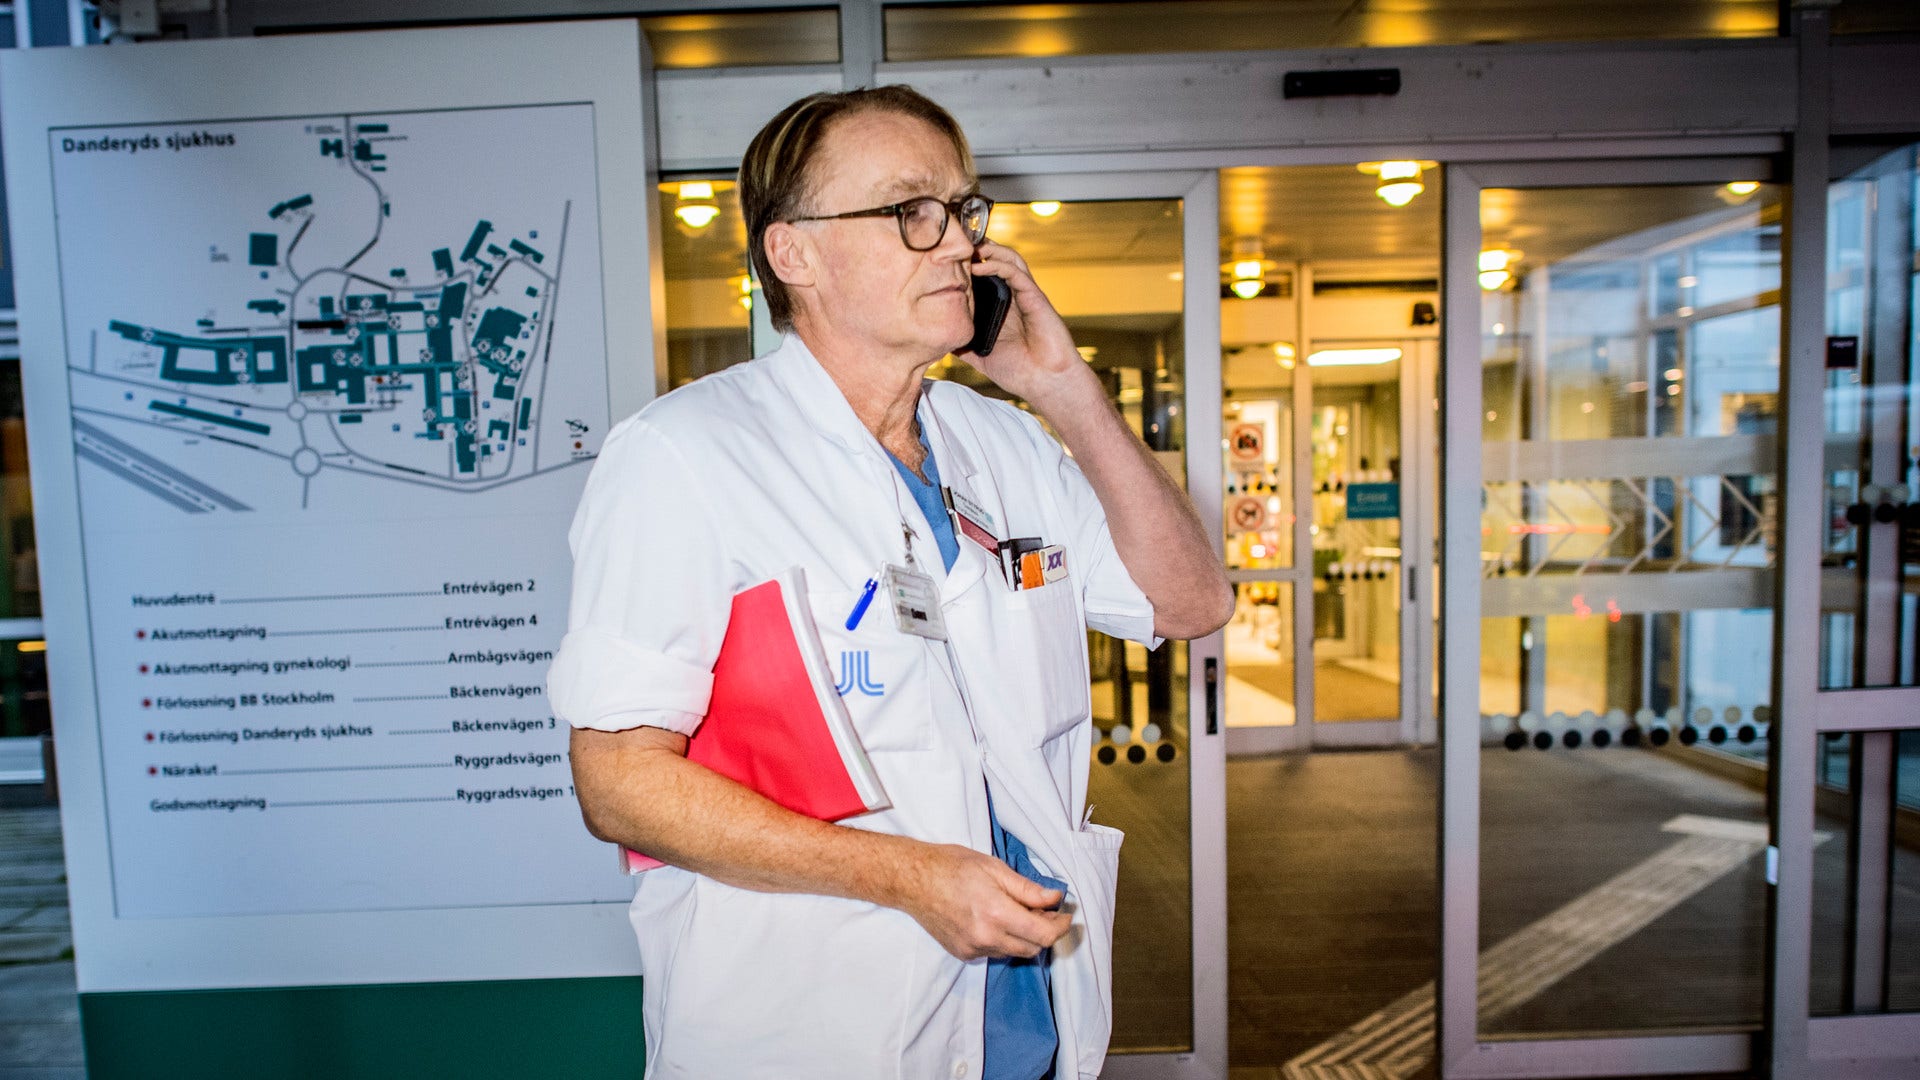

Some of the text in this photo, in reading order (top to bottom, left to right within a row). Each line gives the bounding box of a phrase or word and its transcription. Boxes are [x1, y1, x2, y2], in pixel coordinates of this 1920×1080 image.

[62, 130, 236, 154] Danderyds sjukhus
[132, 579, 536, 607] Huvudentré Entrévägen 2
[151, 614, 538, 642] Akutmottagning Entrévägen 4
[154, 649, 553, 676] Akutmottagning gynekologi Armbågsvägen
[156, 684, 542, 711] Förlossning BB Stockholm Bäckenvägen
[159, 717, 556, 744] Förlossning Danderyds sjukhus Bäckenvägen 3
[162, 752, 562, 777] Närakut Ryggradsvägen
[150, 795, 267, 813] Godsmottagning
[456, 786, 564, 803] Ryggradsvägen
